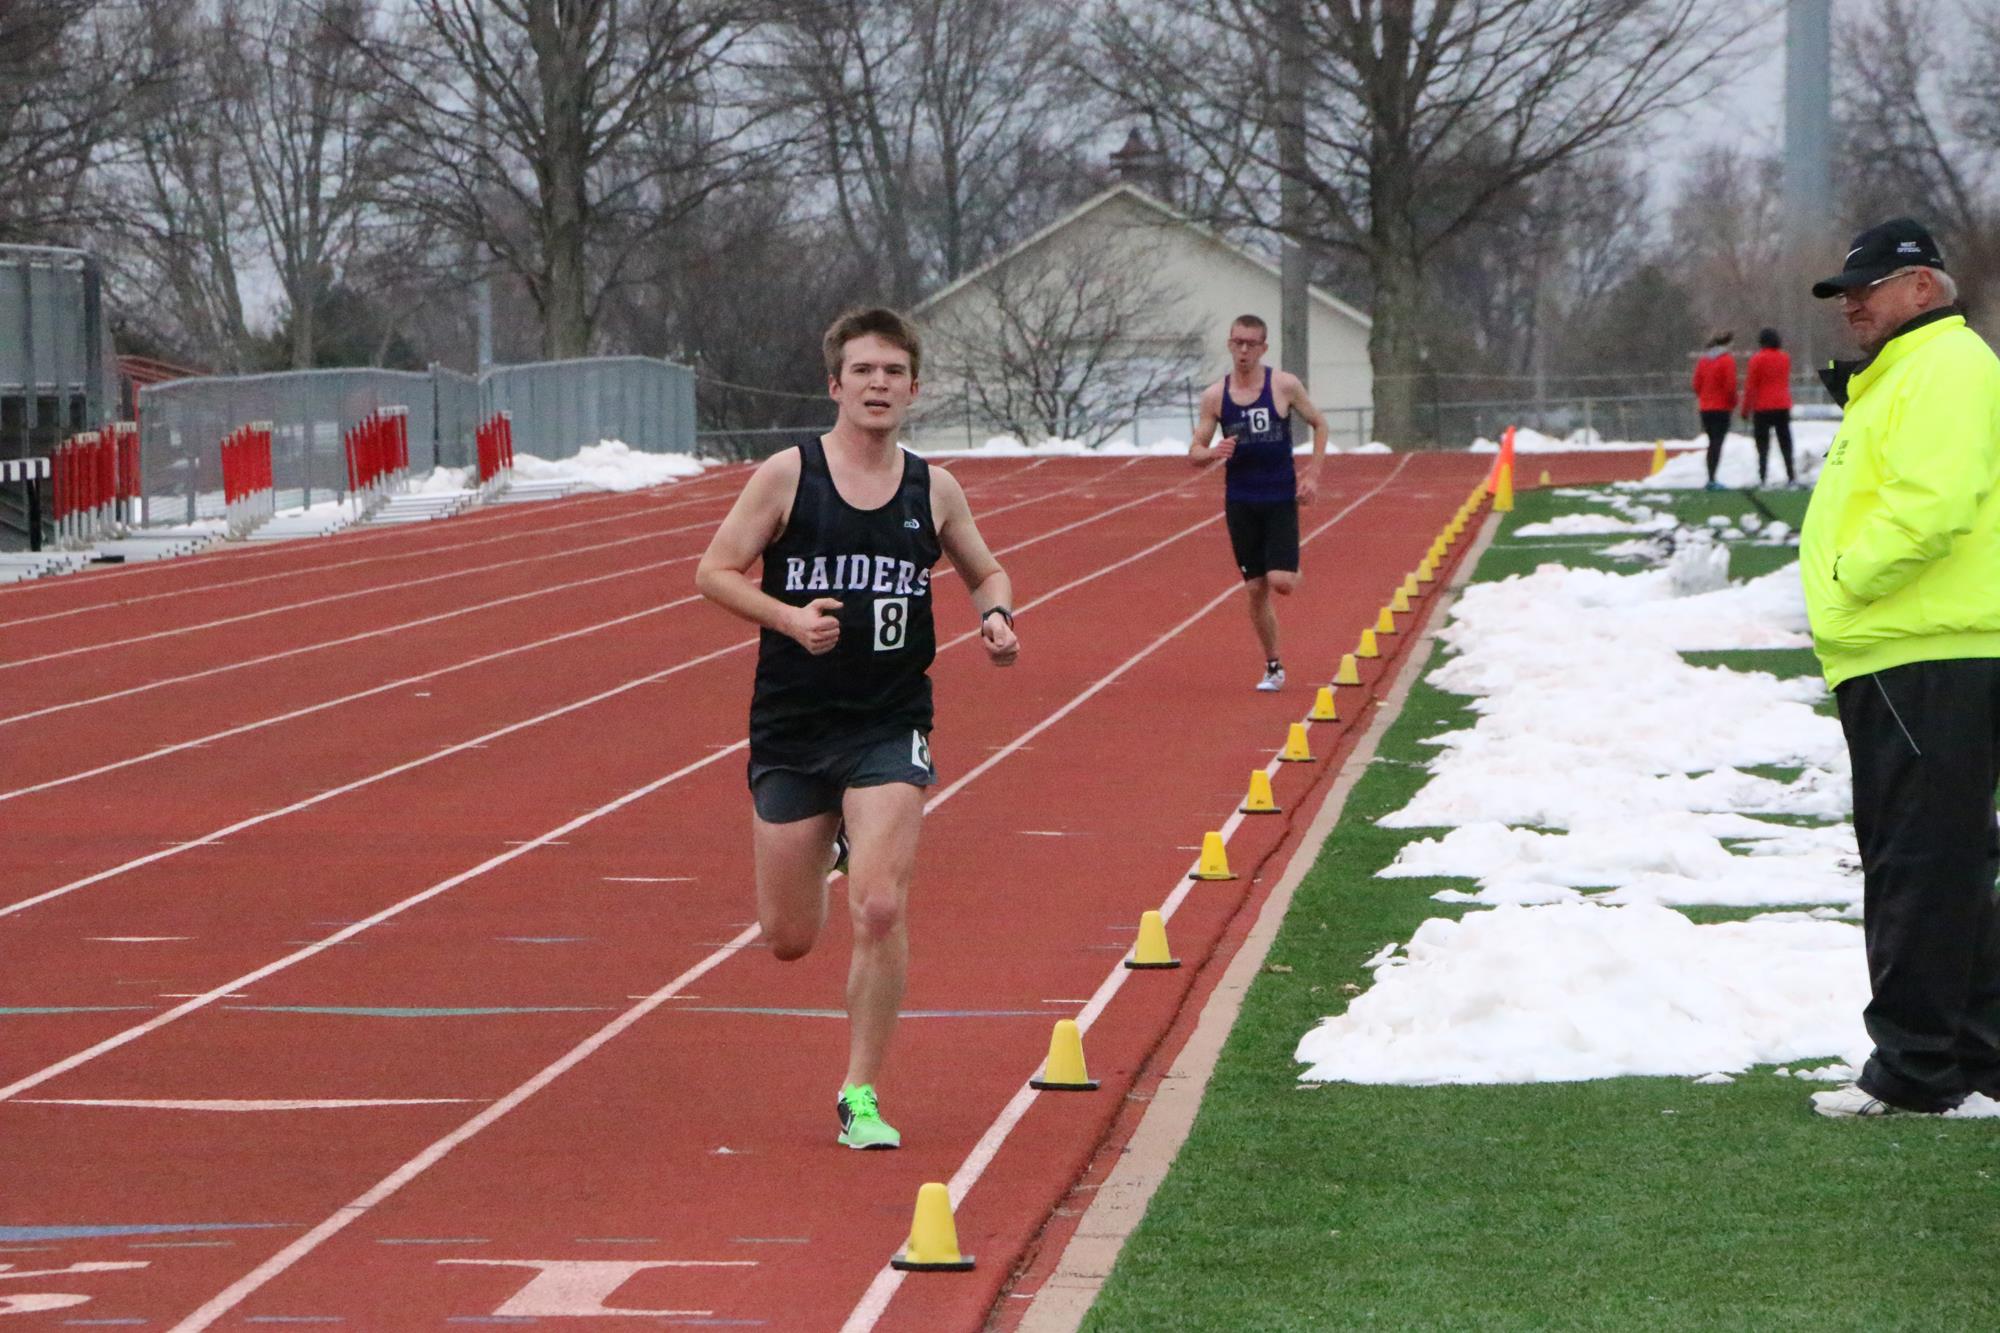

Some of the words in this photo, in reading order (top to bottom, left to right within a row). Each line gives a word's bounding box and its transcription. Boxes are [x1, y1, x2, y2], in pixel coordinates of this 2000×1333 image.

[1253, 410, 1266, 431] 6
[785, 554, 931, 596] RAIDERS
[879, 602, 903, 647] 8
